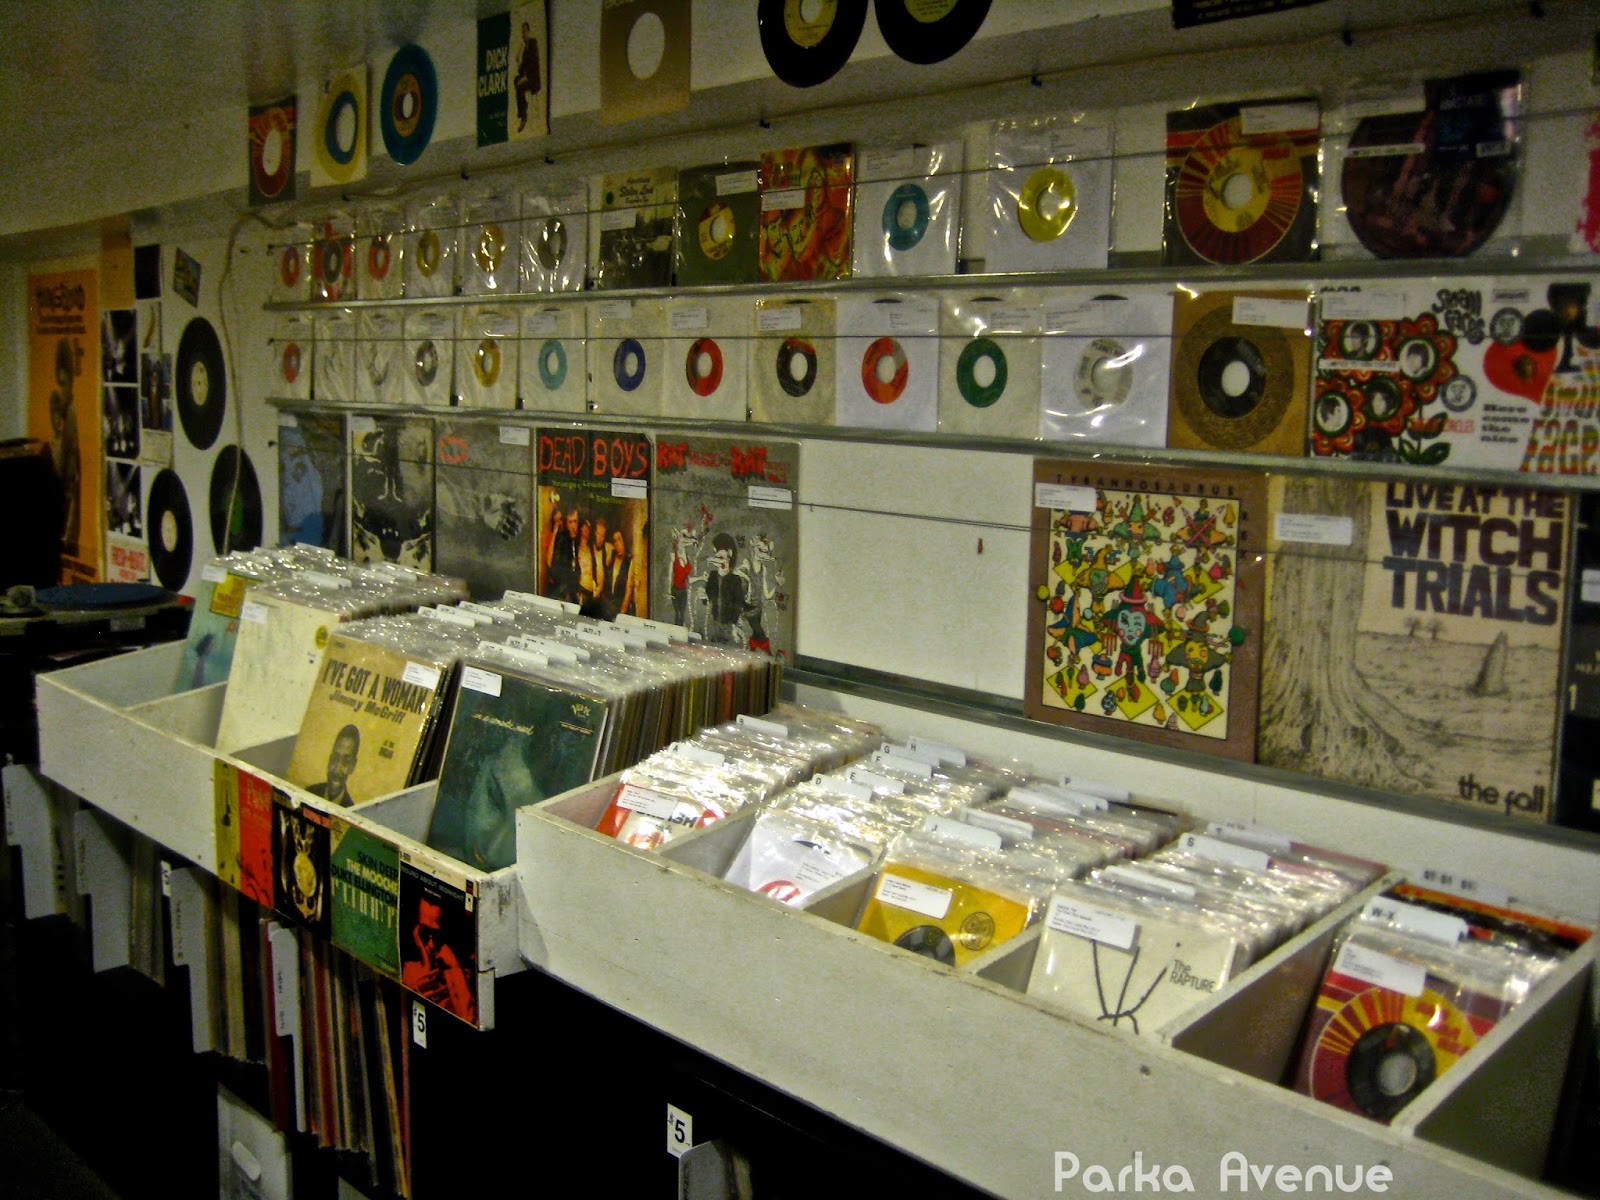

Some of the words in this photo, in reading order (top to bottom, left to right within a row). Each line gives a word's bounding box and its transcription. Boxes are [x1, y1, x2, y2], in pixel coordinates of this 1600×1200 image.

[486, 46, 508, 72] DICK
[478, 70, 508, 97] CLARK
[538, 435, 586, 476] DEAD
[593, 438, 649, 480] BOYS
[1386, 481, 1455, 511] LIVE
[1458, 484, 1498, 515] AT
[1500, 488, 1565, 518] THE
[1386, 509, 1564, 571] WITCH
[1383, 556, 1561, 626] TRIALS
[345, 665, 372, 696] GOT
[368, 673, 381, 700] A
[381, 675, 431, 715] WOMAN
[364, 700, 406, 725] McGriff
[1458, 773, 1499, 805] the
[1504, 784, 1546, 816] fall
[332, 863, 353, 885] DUKE
[346, 858, 362, 874] THE
[1174, 959, 1192, 975] The
[1170, 971, 1216, 993] RAPTURE
